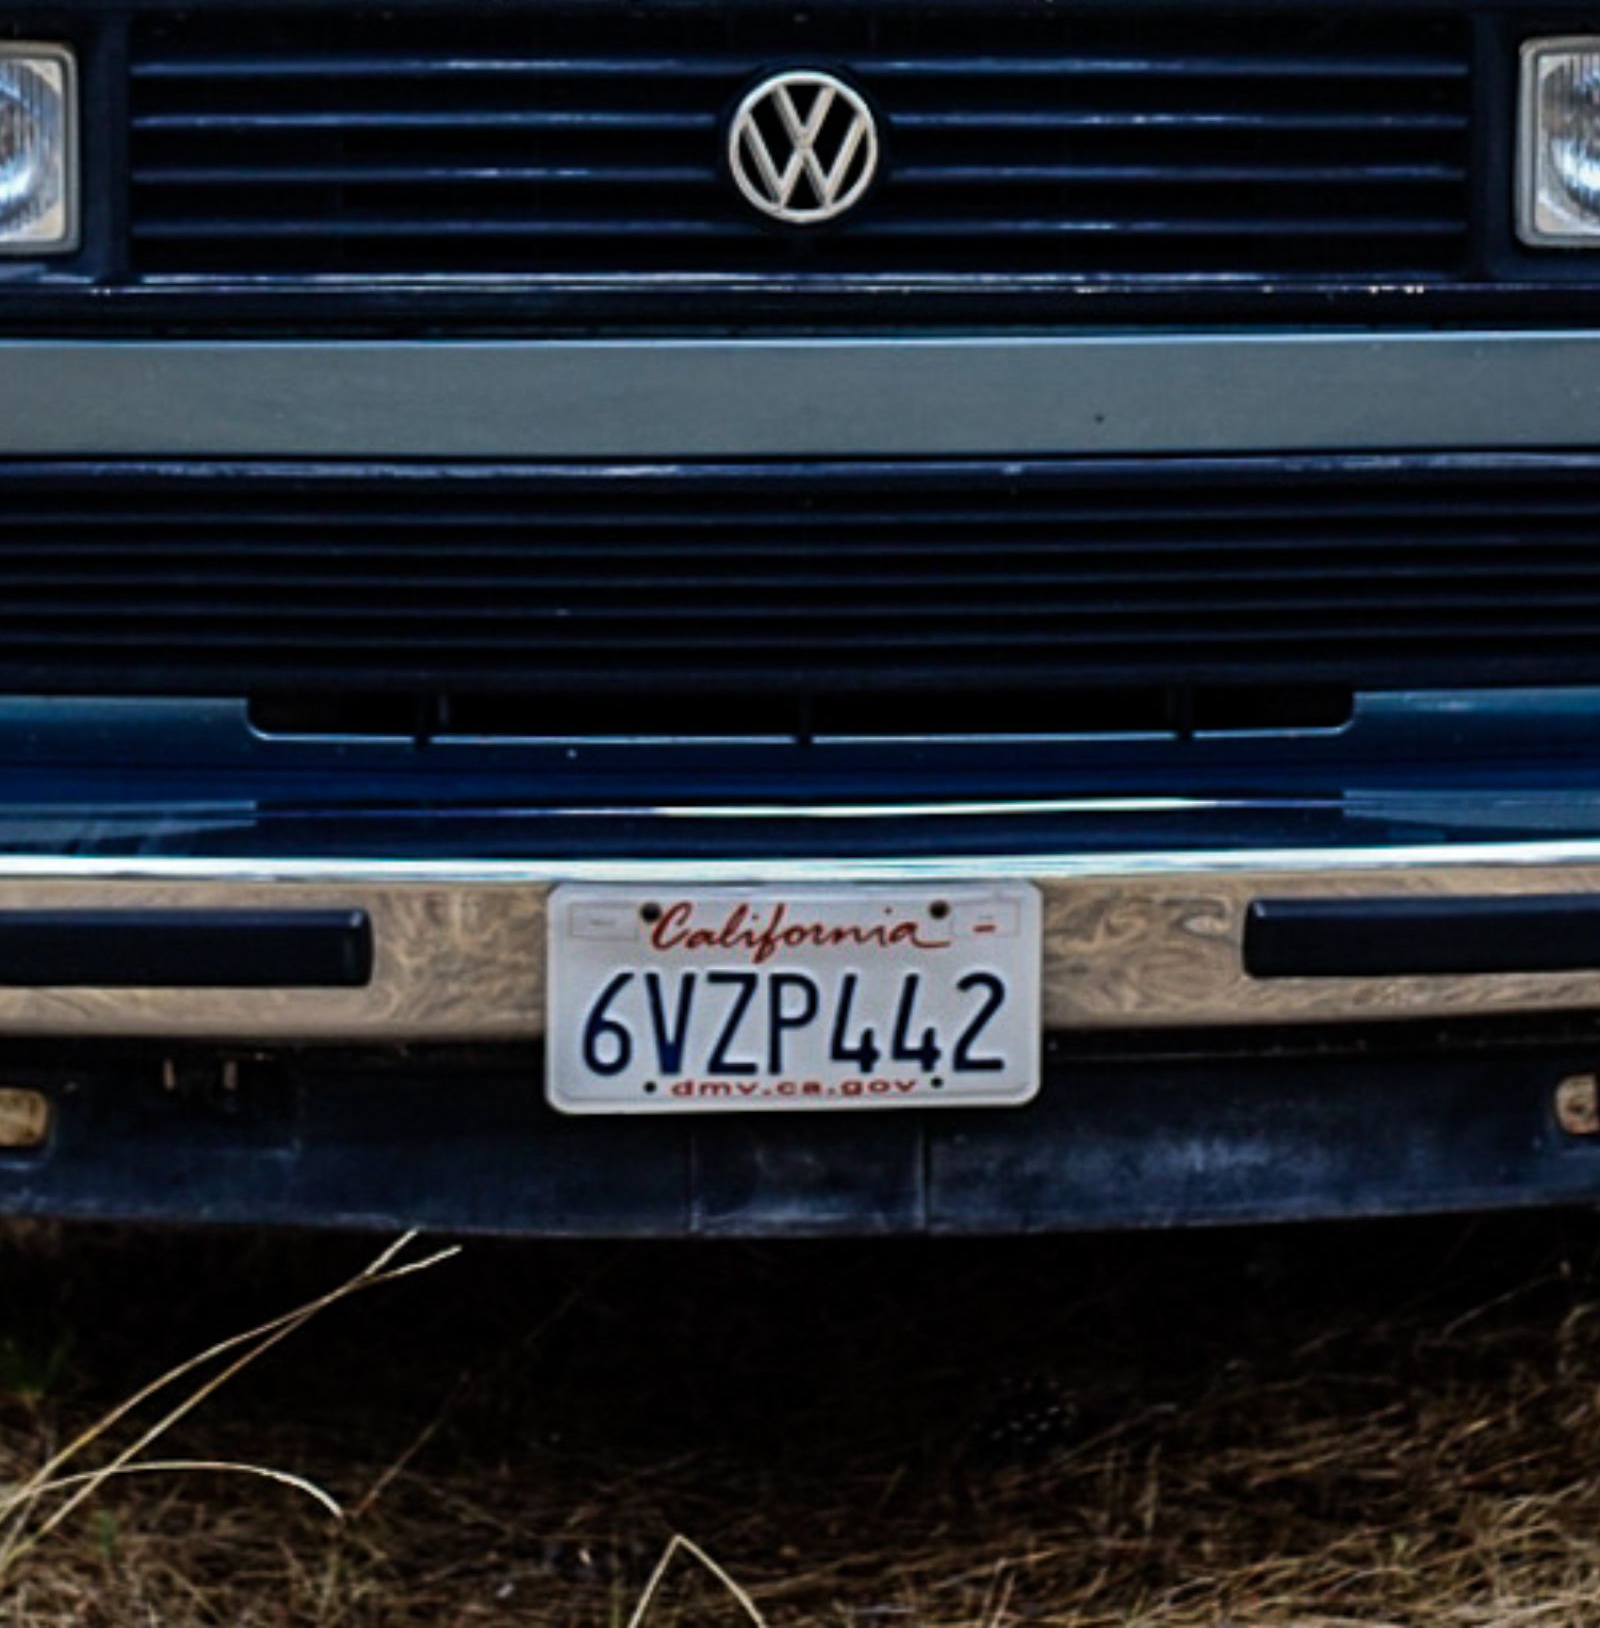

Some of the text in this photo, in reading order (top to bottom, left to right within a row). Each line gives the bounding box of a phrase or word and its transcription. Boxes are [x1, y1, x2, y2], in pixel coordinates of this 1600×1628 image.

[728, 70, 878, 223] VW
[650, 903, 950, 964] California
[582, 973, 1005, 1077] 6VZP442
[671, 1079, 917, 1098] dmv.ca.gov
